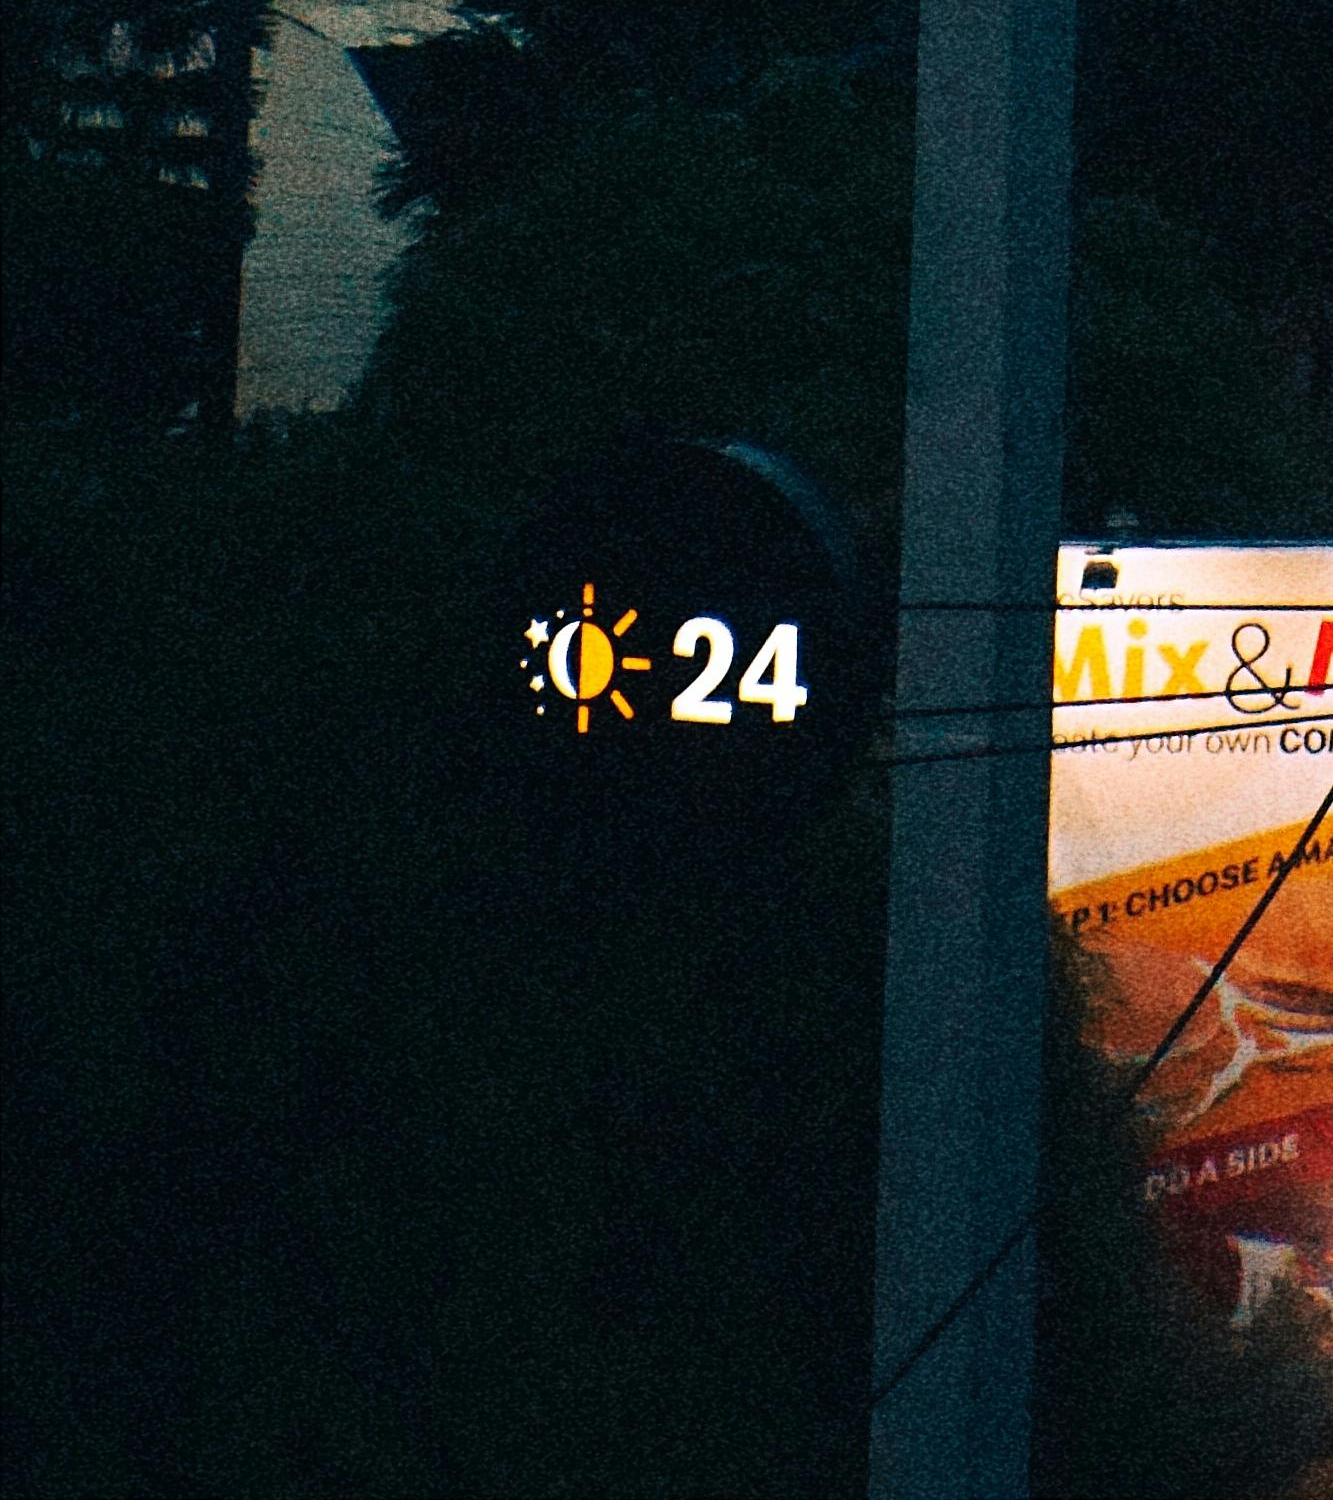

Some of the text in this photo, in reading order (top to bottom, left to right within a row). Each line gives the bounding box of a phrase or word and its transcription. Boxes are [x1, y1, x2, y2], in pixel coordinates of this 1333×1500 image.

[671, 616, 808, 725] 24
[1053, 618, 1210, 702] Mix
[1225, 622, 1301, 713] &
[1205, 732, 1271, 754] own
[1124, 855, 1260, 918] CHOOSE
[1226, 1132, 1300, 1179] SIDE
